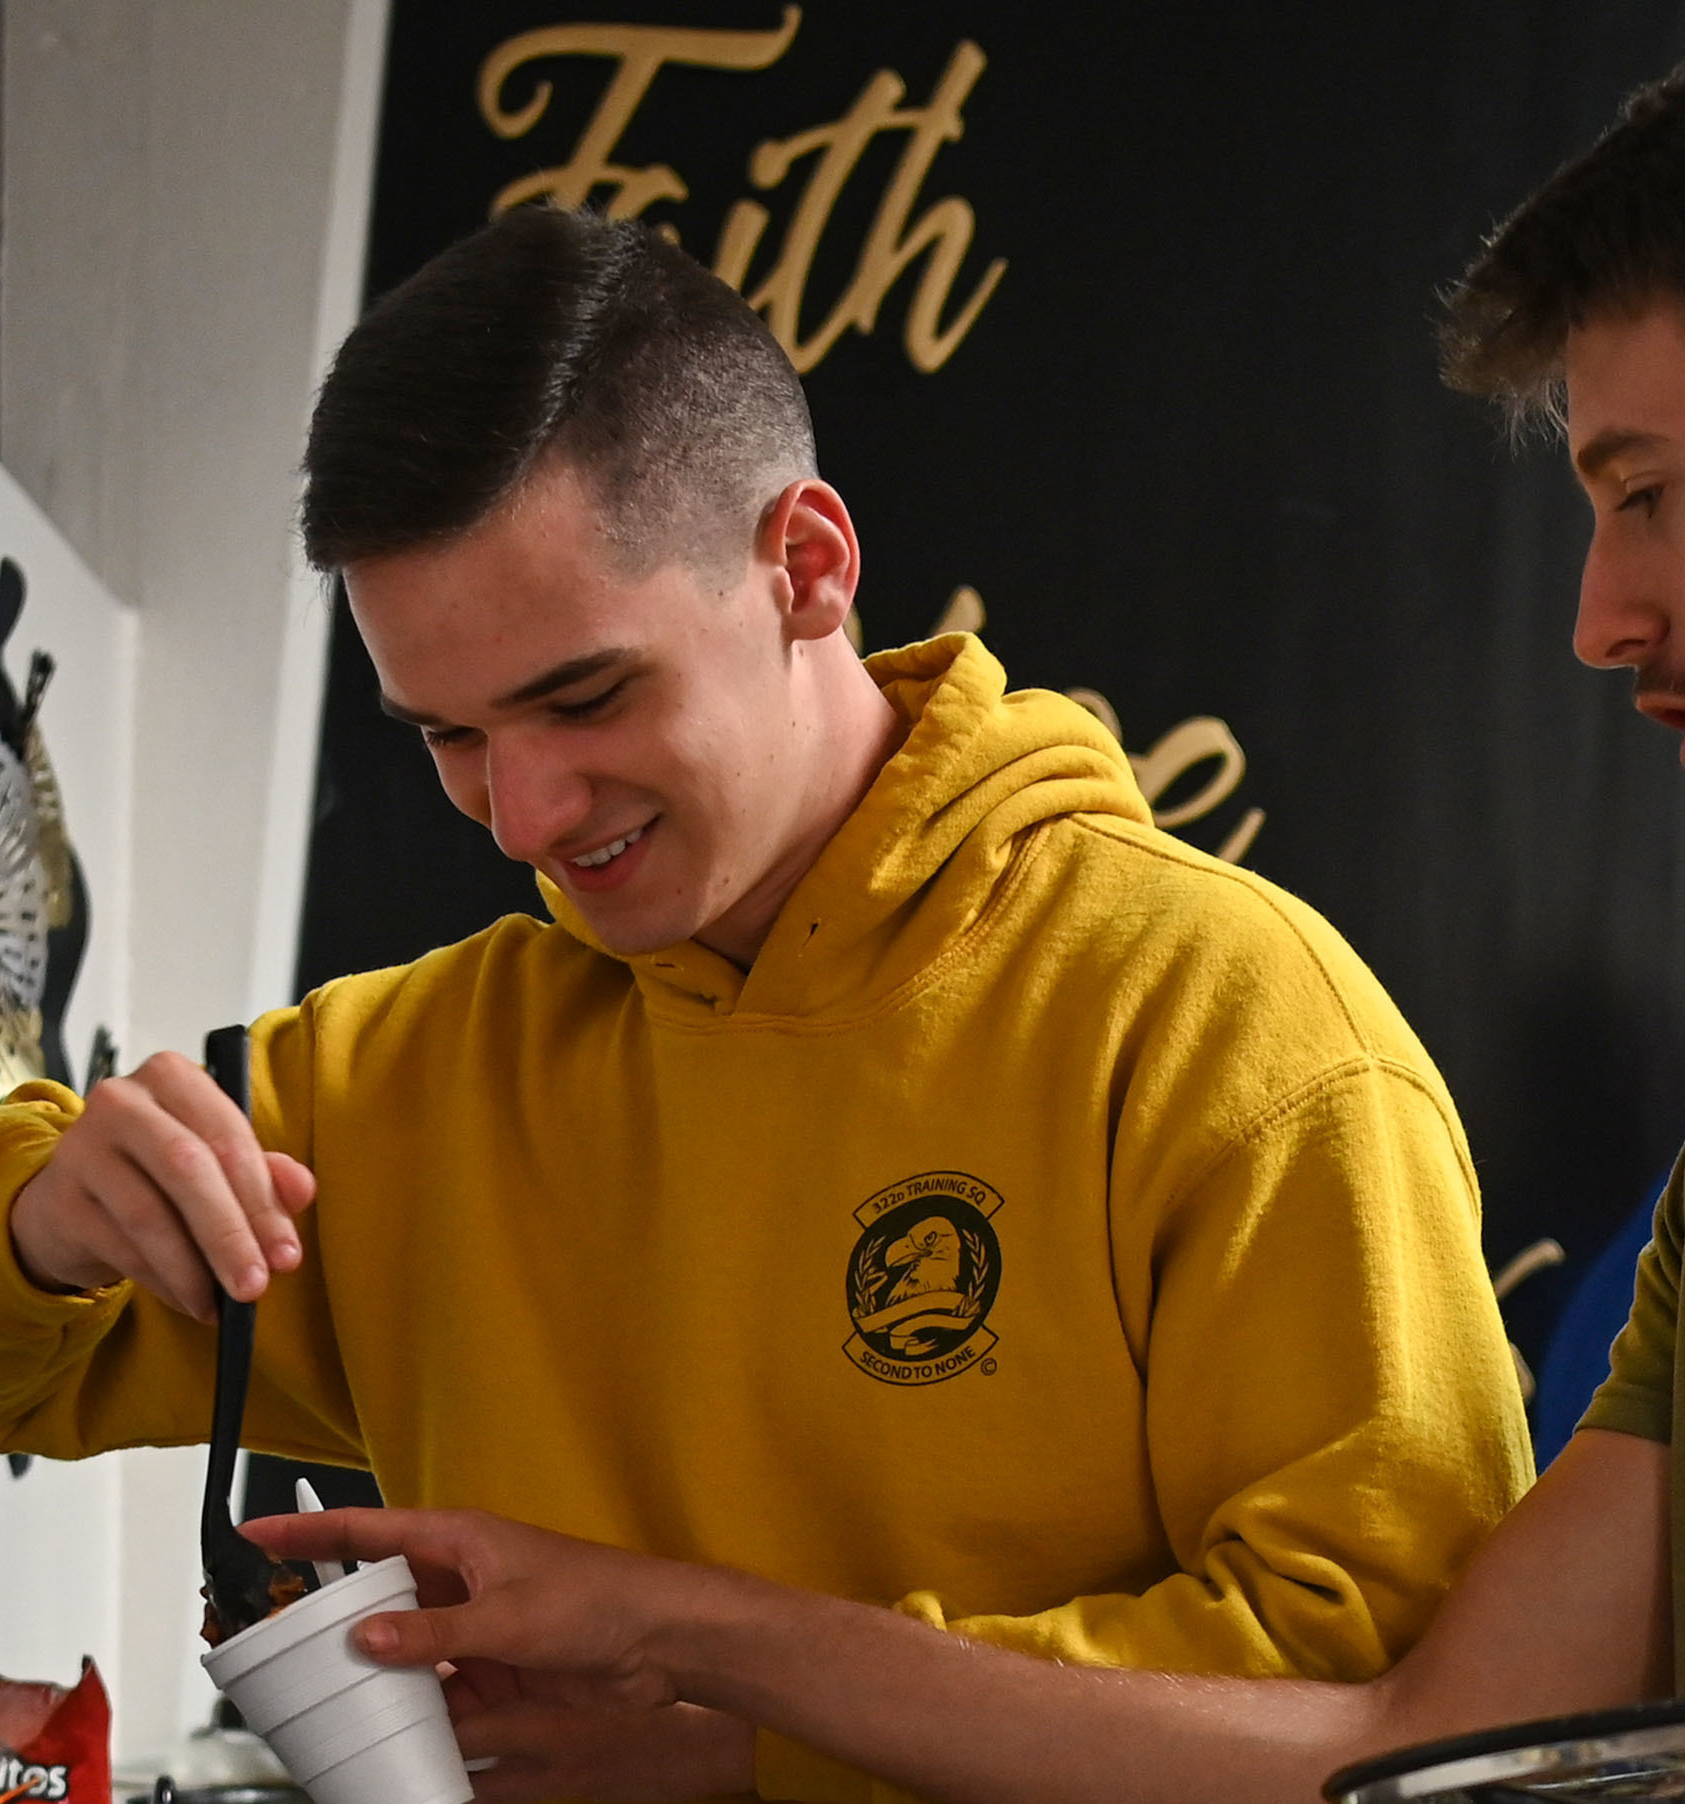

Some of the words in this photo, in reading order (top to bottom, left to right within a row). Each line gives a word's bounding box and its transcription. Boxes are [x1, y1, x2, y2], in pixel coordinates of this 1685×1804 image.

[476, 4, 1008, 373] Fith
[906, 1178, 967, 1197] TRAINING
[966, 1185, 986, 1206] SQ
[860, 1351, 912, 1380] SECOND
[911, 1365, 933, 1379] TO
[935, 1345, 976, 1376] NONE
